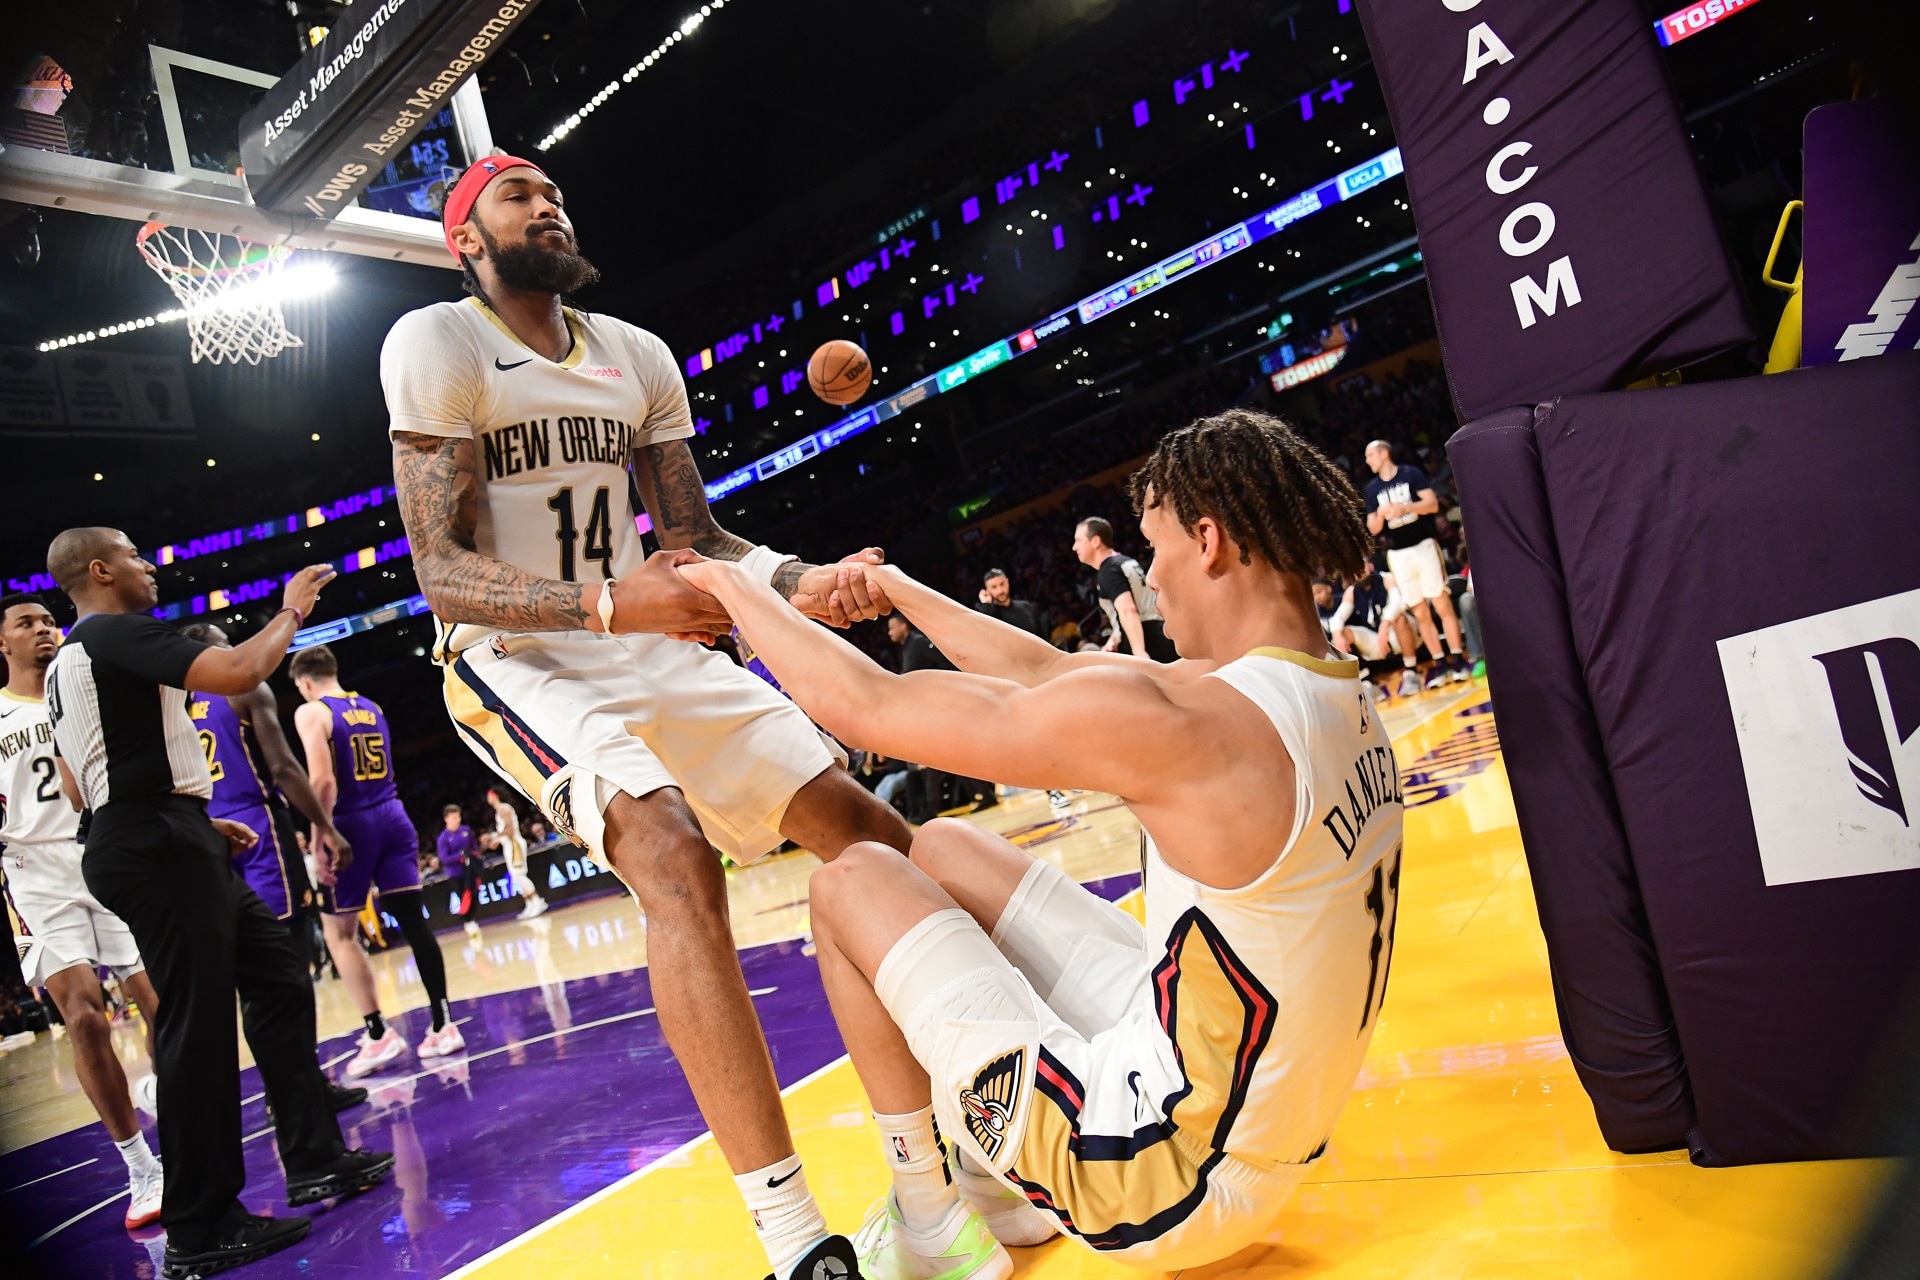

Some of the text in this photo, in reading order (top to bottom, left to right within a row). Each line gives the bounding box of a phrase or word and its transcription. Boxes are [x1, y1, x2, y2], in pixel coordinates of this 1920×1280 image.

[1669, 0, 1750, 35] TOSH
[263, 0, 405, 147] Asset Manageme
[322, 162, 368, 202] DWS
[363, 109, 423, 156] Asset
[406, 0, 531, 110] Managemen
[1348, 166, 1381, 189] UCLA
[1441, 0, 1582, 329] A.COM
[887, 208, 926, 237] DELTA
[1034, 317, 1071, 340] TOYOTA
[584, 363, 623, 378] ibotta
[969, 347, 1002, 375] Sprite
[481, 417, 551, 481] NEW
[704, 470, 752, 500] Spectrum
[547, 485, 618, 582] 14
[349, 731, 388, 781] 15
[32, 756, 60, 803] 2
